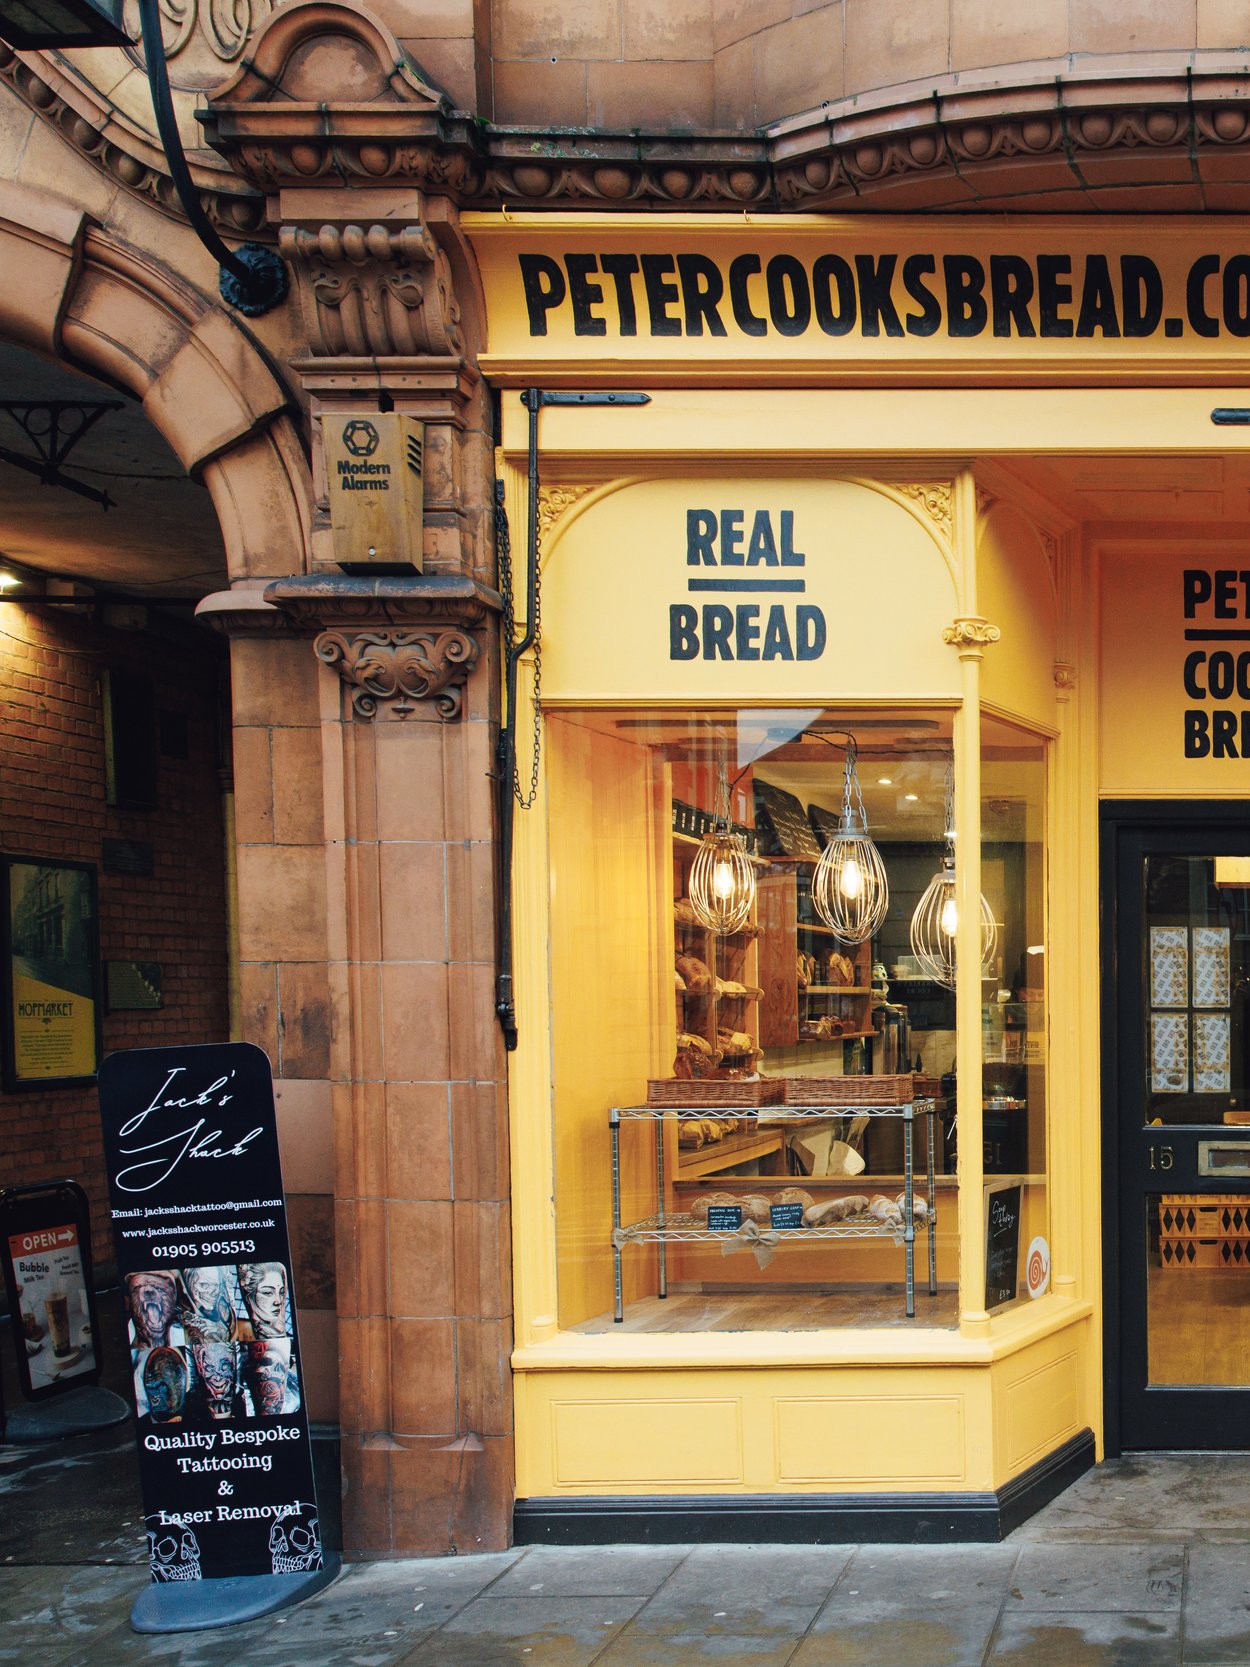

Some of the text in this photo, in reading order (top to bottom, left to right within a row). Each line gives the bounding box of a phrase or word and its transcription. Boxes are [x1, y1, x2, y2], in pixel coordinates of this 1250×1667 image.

[337, 459, 391, 475] Modern
[341, 475, 390, 490] Alarms
[686, 509, 806, 566] REAL
[669, 604, 827, 661] BREAD
[18, 1003, 74, 1018] HOPMARKET
[119, 1067, 236, 1137] Jack's
[115, 1118, 264, 1192] Shack
[1148, 1145, 1173, 1170] 15
[111, 1199, 283, 1219] Email: jacksshacktattoo@gmail.com
[121, 1219, 276, 1239] www.jacksshackworcester.co.uk
[22, 1231, 58, 1250] OPEN
[151, 1240, 256, 1258] 01905 905513
[19, 1261, 50, 1273] Bubble
[144, 1425, 301, 1452] Quality Bespoke
[177, 1453, 273, 1474] Tattooing
[217, 1480, 234, 1496] &
[158, 1500, 303, 1526] Laser Removal
